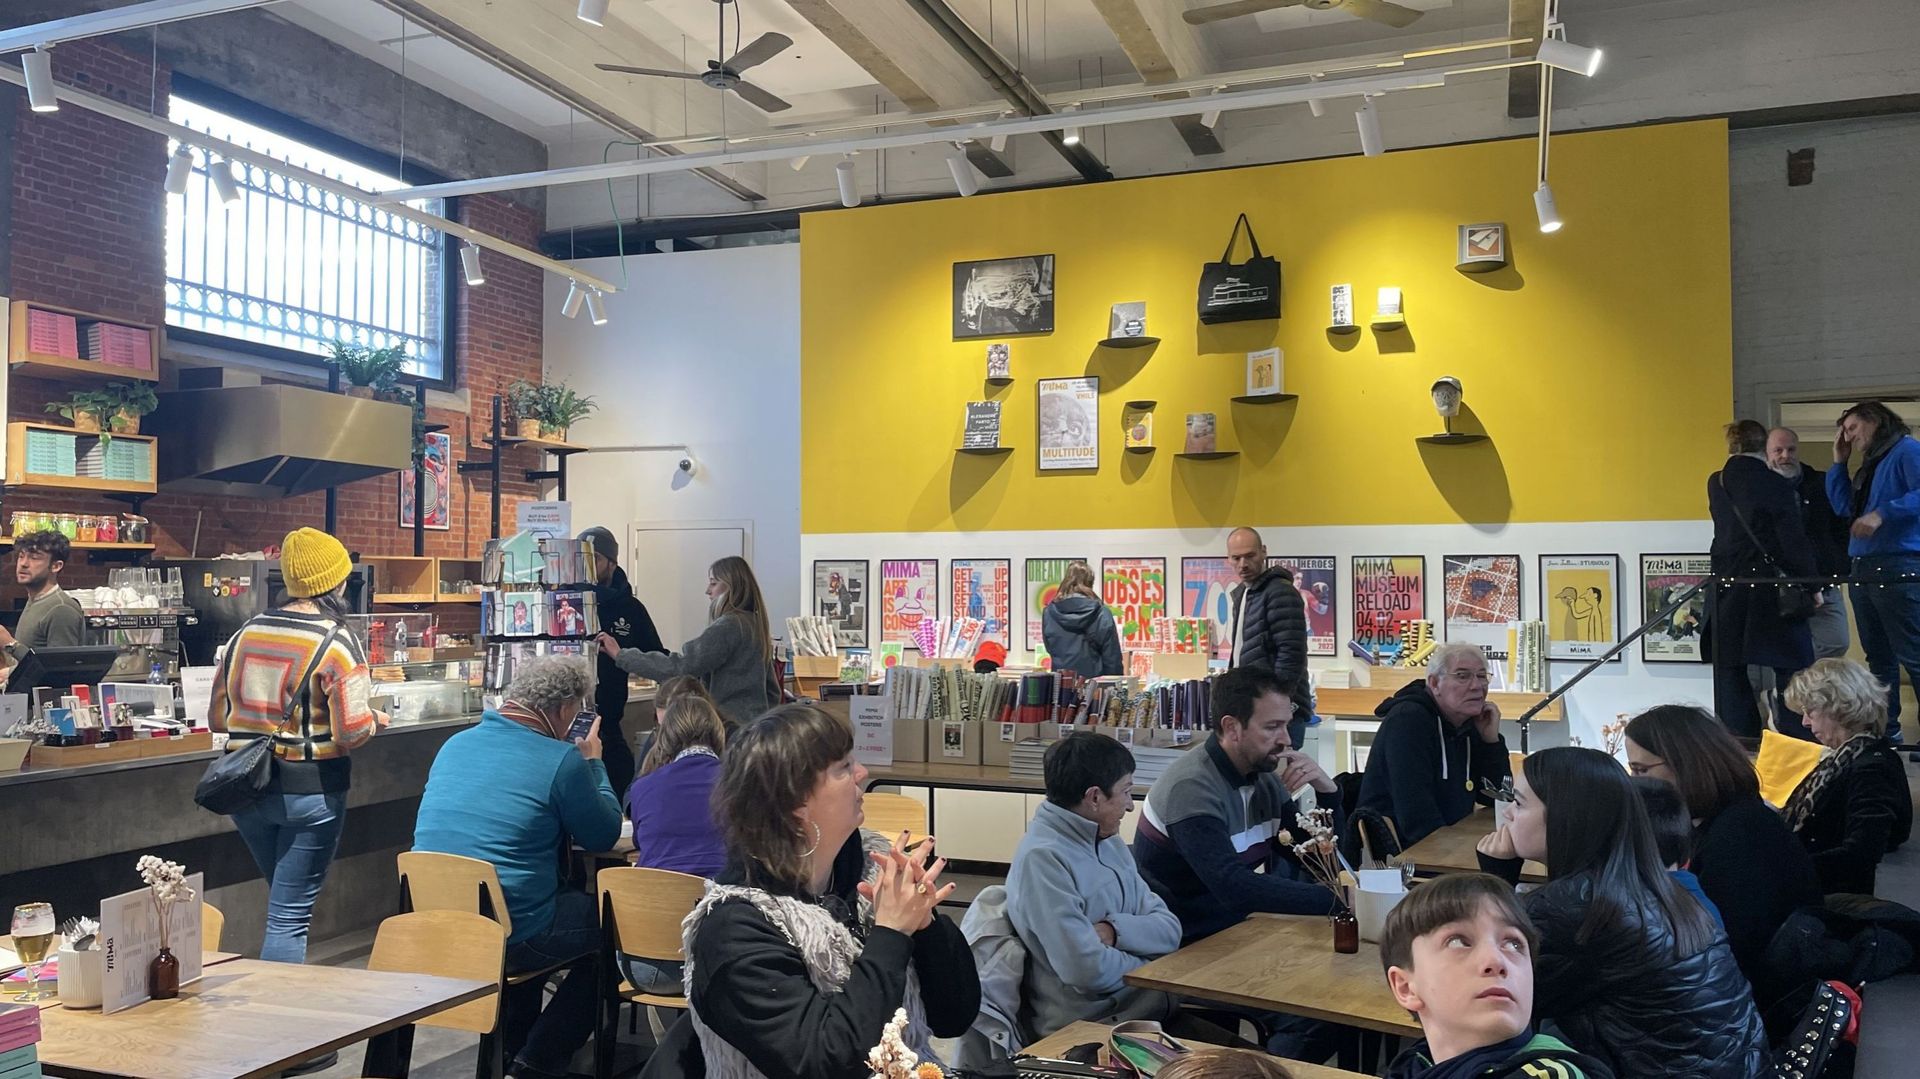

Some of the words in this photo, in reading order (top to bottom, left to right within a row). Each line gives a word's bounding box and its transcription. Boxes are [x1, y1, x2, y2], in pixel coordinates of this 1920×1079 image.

[1042, 447, 1095, 458] MULTITUDE
[883, 561, 920, 578] MIMA
[1300, 559, 1334, 569] HEROES
[1355, 559, 1395, 576] MIMA
[954, 568, 973, 580] GET
[994, 568, 1008, 580] UP
[883, 579, 908, 596] ART
[954, 580, 973, 593] GET
[994, 580, 1008, 593] UP
[1355, 576, 1419, 593] MUSEUM
[883, 598, 895, 613] IS
[954, 593, 973, 606] GET
[994, 593, 1008, 606] UP
[1356, 593, 1411, 611] RELOAD
[954, 605, 986, 618] STAND
[994, 605, 1008, 618] UP
